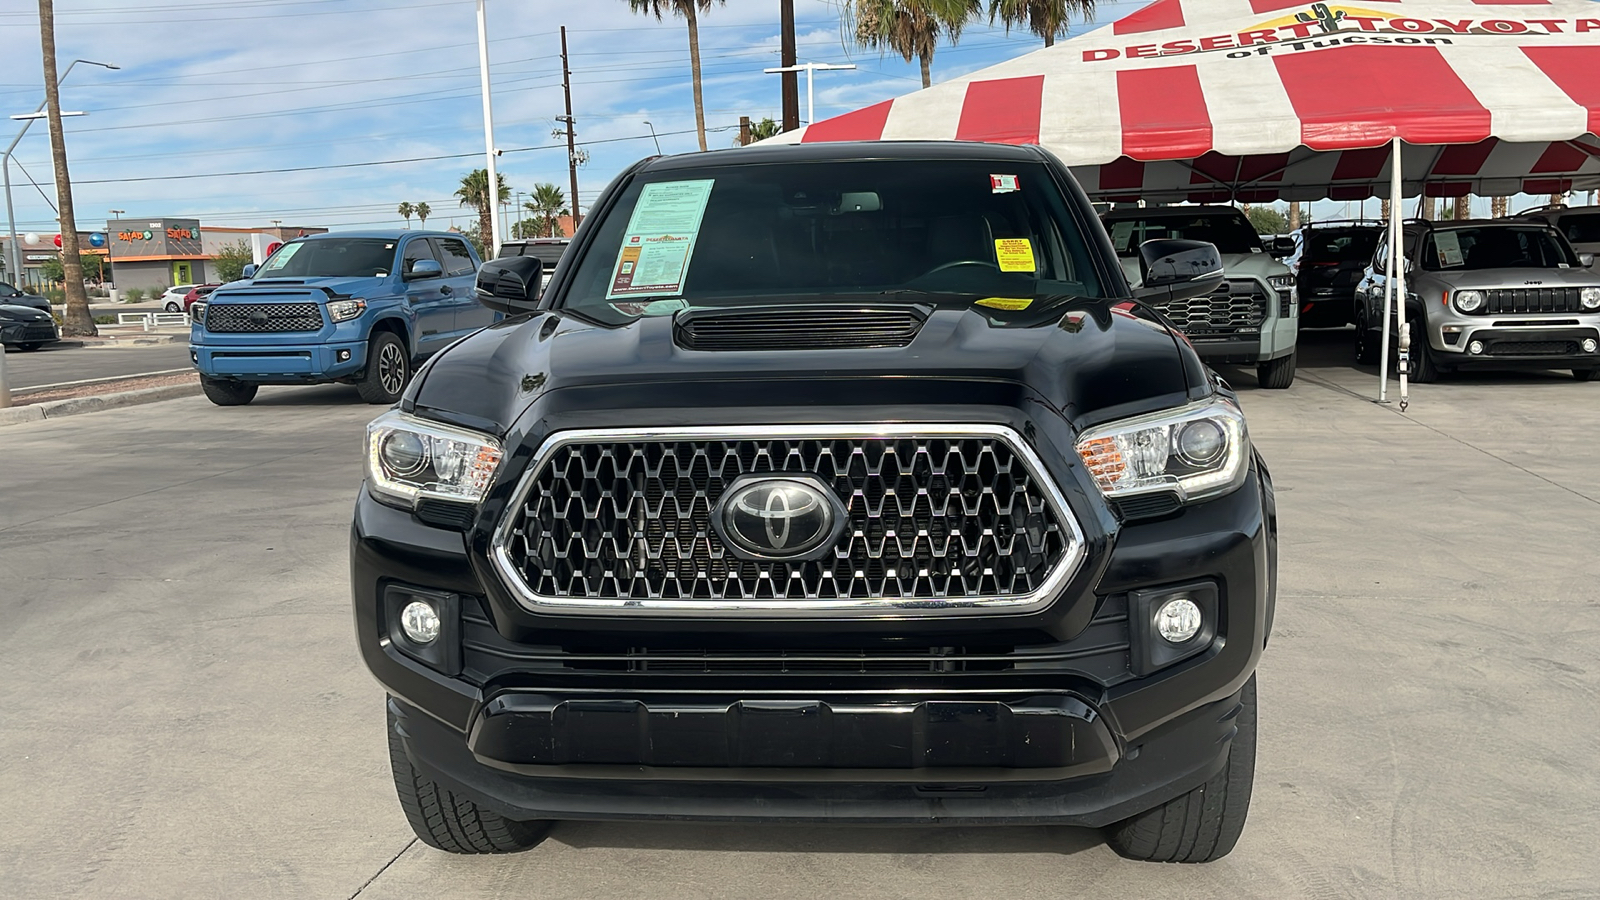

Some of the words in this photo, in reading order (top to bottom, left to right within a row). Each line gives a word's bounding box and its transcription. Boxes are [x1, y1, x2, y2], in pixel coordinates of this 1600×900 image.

[1082, 21, 1319, 62] DESERT
[1343, 16, 1600, 33] TOYOTA
[1226, 46, 1272, 58] of
[1281, 36, 1453, 50] Tucson
[118, 231, 143, 242] SALAD
